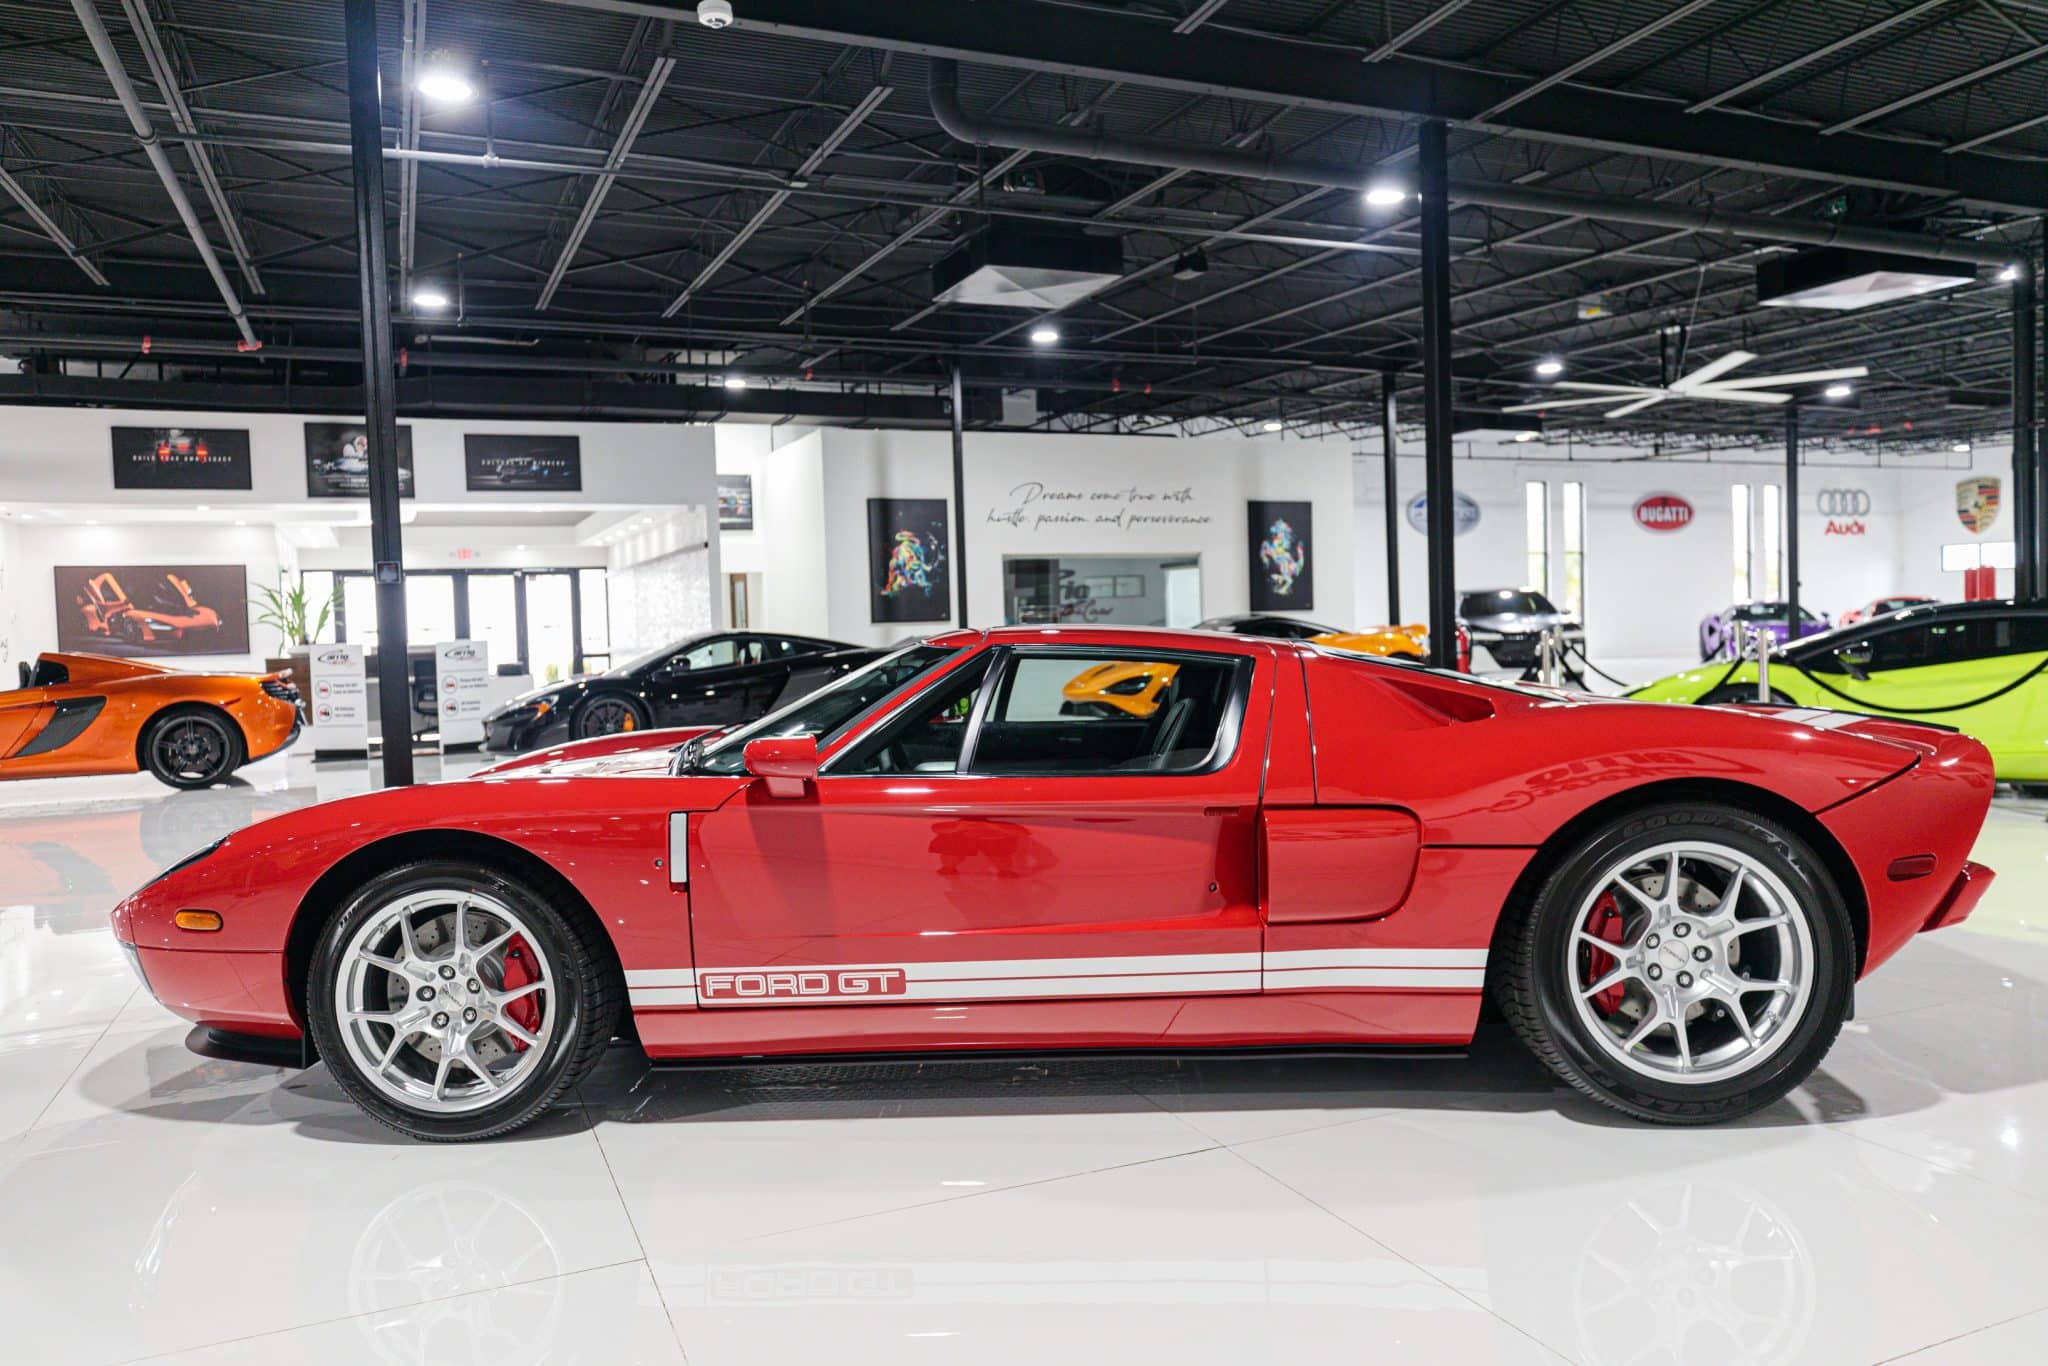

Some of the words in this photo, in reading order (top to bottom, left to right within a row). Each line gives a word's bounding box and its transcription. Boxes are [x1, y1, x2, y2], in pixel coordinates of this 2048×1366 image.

[1008, 481, 1083, 505] Dreams
[1089, 492, 1121, 501] come
[1162, 487, 1195, 503] with
[1033, 511, 1088, 532] passion
[1095, 506, 1126, 527] and
[1640, 505, 1690, 522] BUGATTI
[1823, 519, 1866, 537] Audi
[705, 973, 830, 998] FORD
[837, 971, 900, 993] GT
